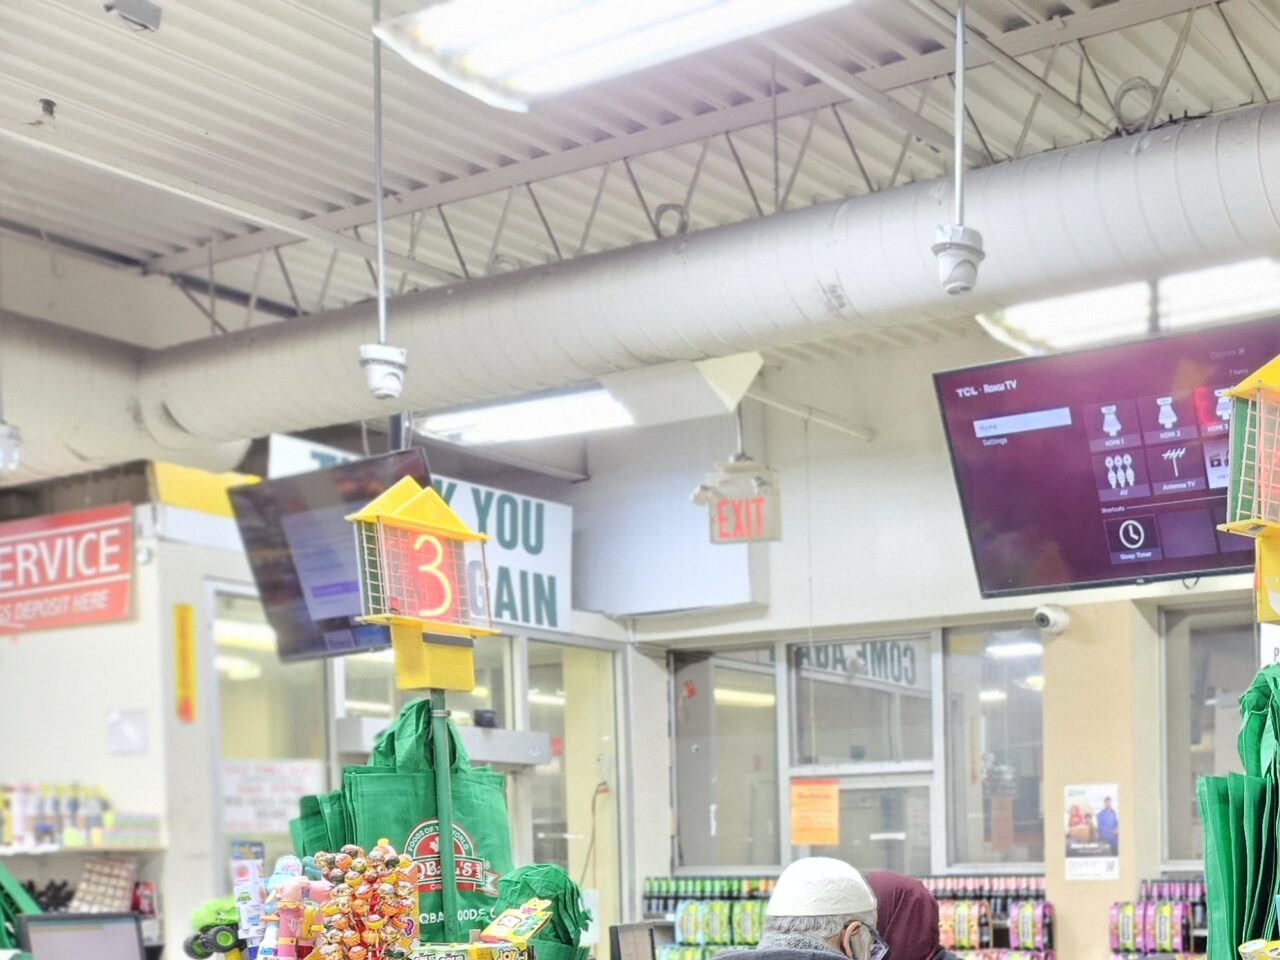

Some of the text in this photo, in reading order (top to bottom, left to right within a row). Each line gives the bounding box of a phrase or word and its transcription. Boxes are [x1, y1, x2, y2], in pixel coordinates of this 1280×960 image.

[956, 386, 978, 398] TCL
[1005, 379, 1017, 390] TV
[1185, 480, 1196, 488] TV
[471, 486, 544, 555] YOU
[716, 496, 765, 540] EXIT
[413, 534, 452, 616] 3
[467, 560, 558, 628] GAIN
